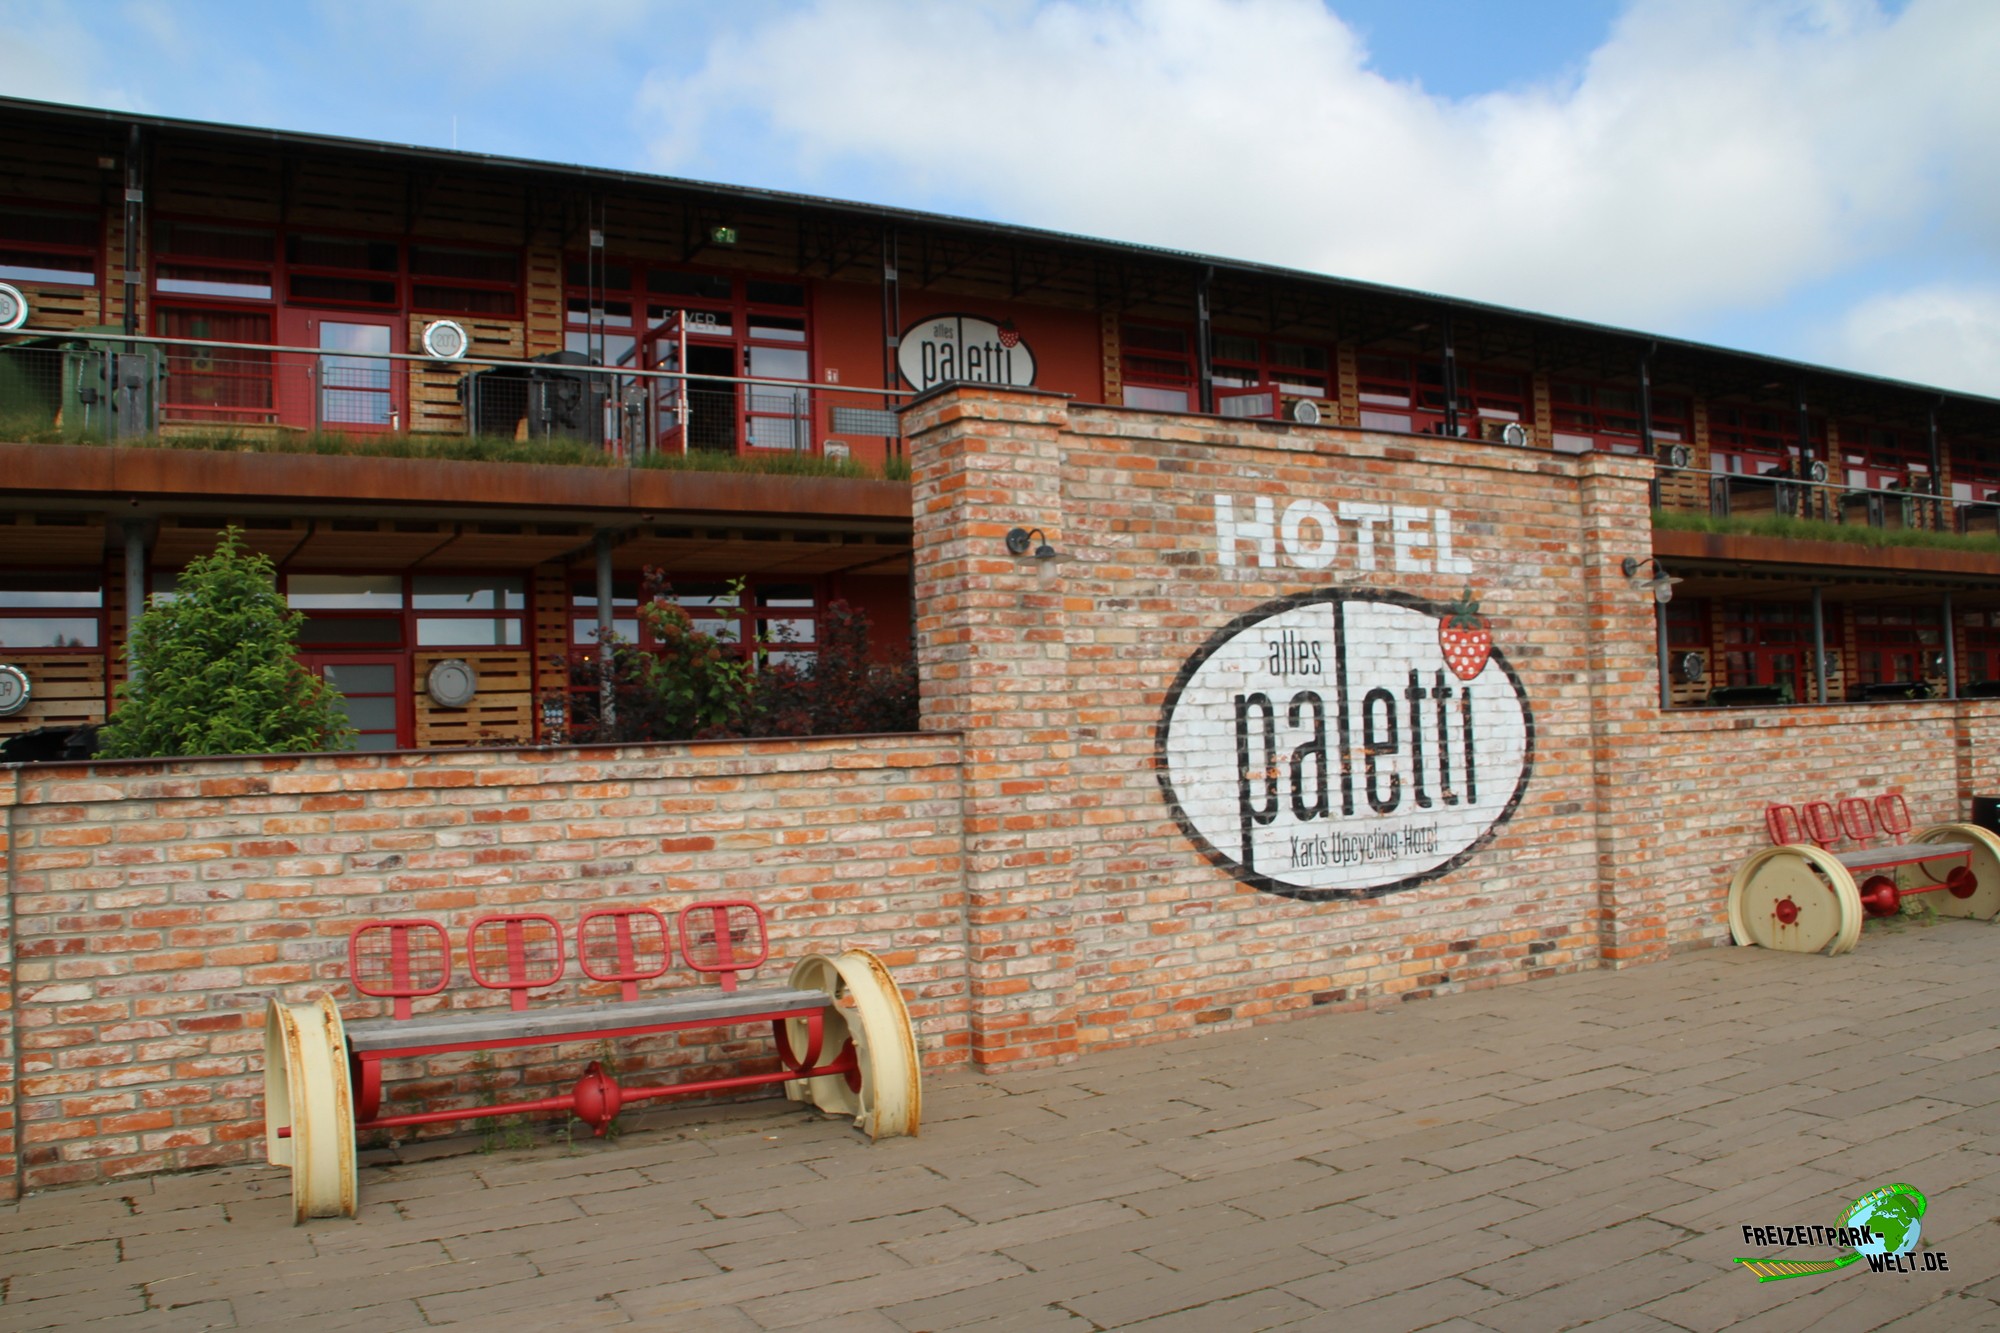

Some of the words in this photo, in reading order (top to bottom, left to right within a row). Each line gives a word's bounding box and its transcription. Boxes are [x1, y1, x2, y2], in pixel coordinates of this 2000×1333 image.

[921, 316, 1012, 390] paletti
[933, 323, 954, 339] alles
[1213, 494, 1473, 574] HOTEL
[1268, 630, 1322, 676] alles
[1234, 601, 1477, 875] paletti
[1290, 834, 1328, 868] Karls
[1332, 821, 1438, 867] Upcycling-Hotel
